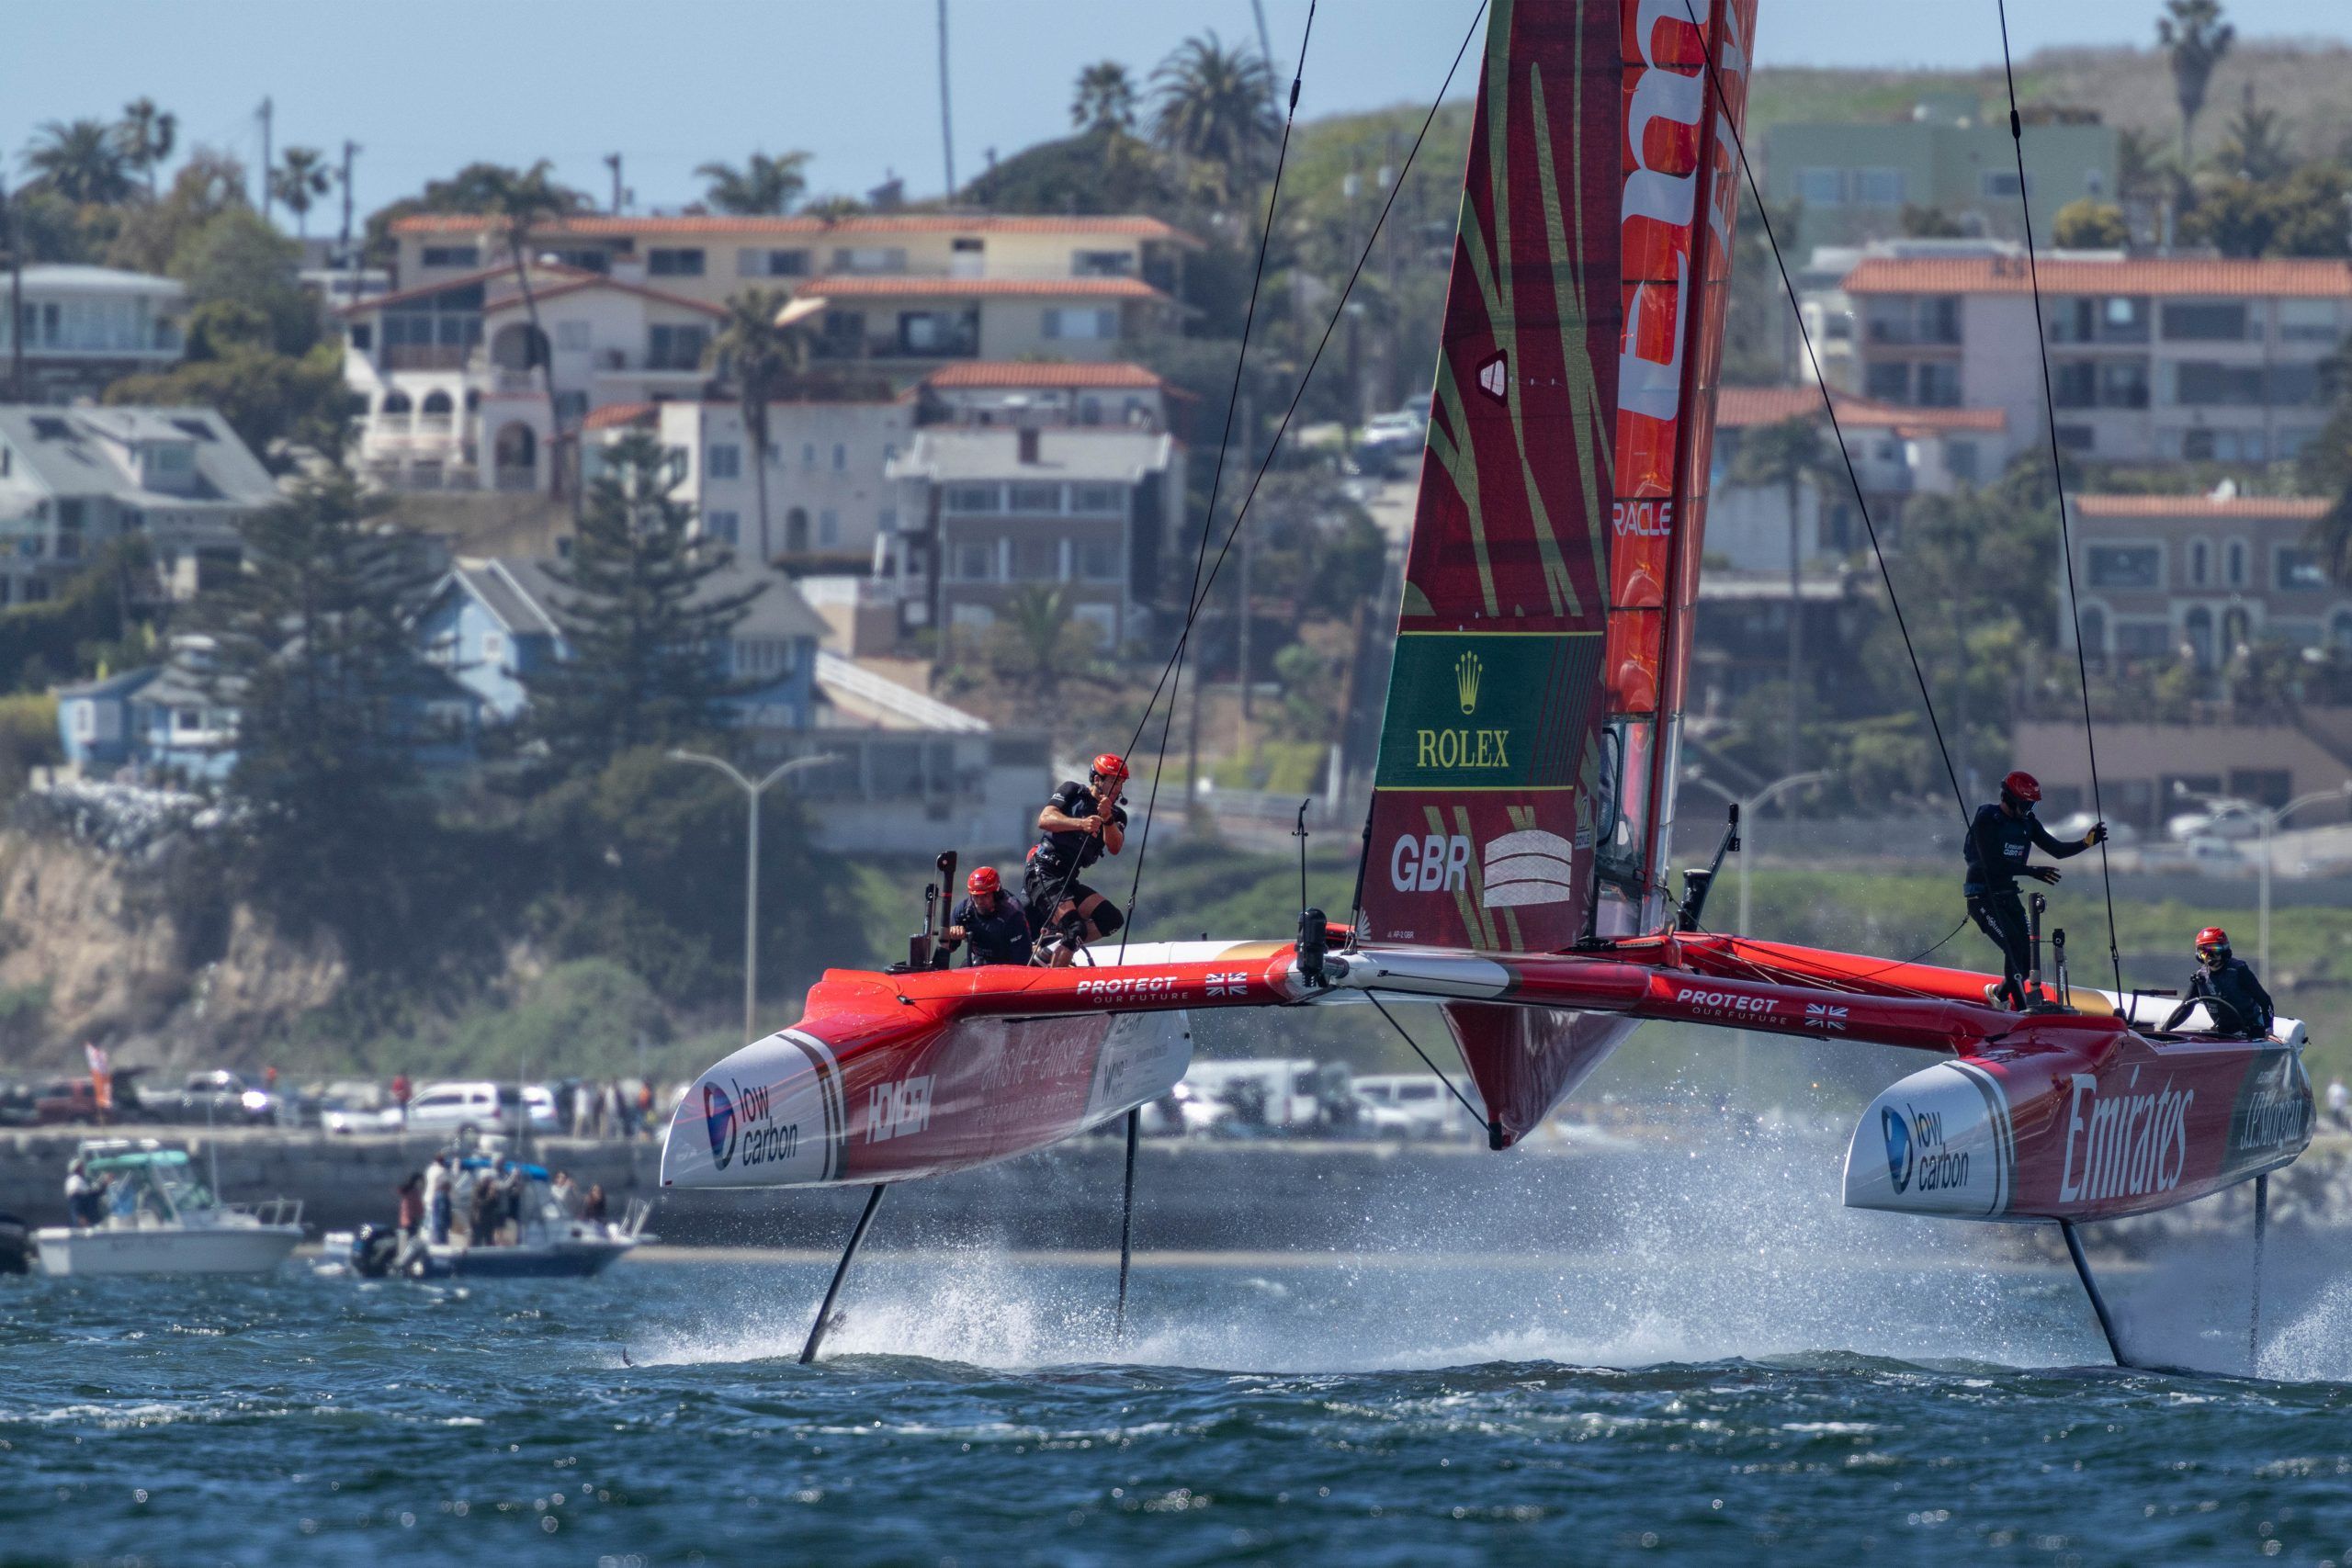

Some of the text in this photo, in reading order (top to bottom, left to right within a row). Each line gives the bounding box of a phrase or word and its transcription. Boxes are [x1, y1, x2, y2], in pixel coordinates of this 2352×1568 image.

[1612, 502, 1672, 536] RACLE
[1416, 728, 1510, 769] ROLEX
[1390, 832, 1471, 893] GBR
[1076, 976, 1179, 996] PROTECT
[1092, 991, 1190, 1004] OUR FUTURE
[1676, 988, 1780, 1013] PROTECT
[1691, 1006, 1788, 1025] OUR FUTURE
[731, 1077, 769, 1122] low
[741, 1114, 798, 1167] carbon
[1906, 1102, 1943, 1148] low
[2058, 1064, 2195, 1203] Emirates
[1918, 1141, 1970, 1192] carbon
